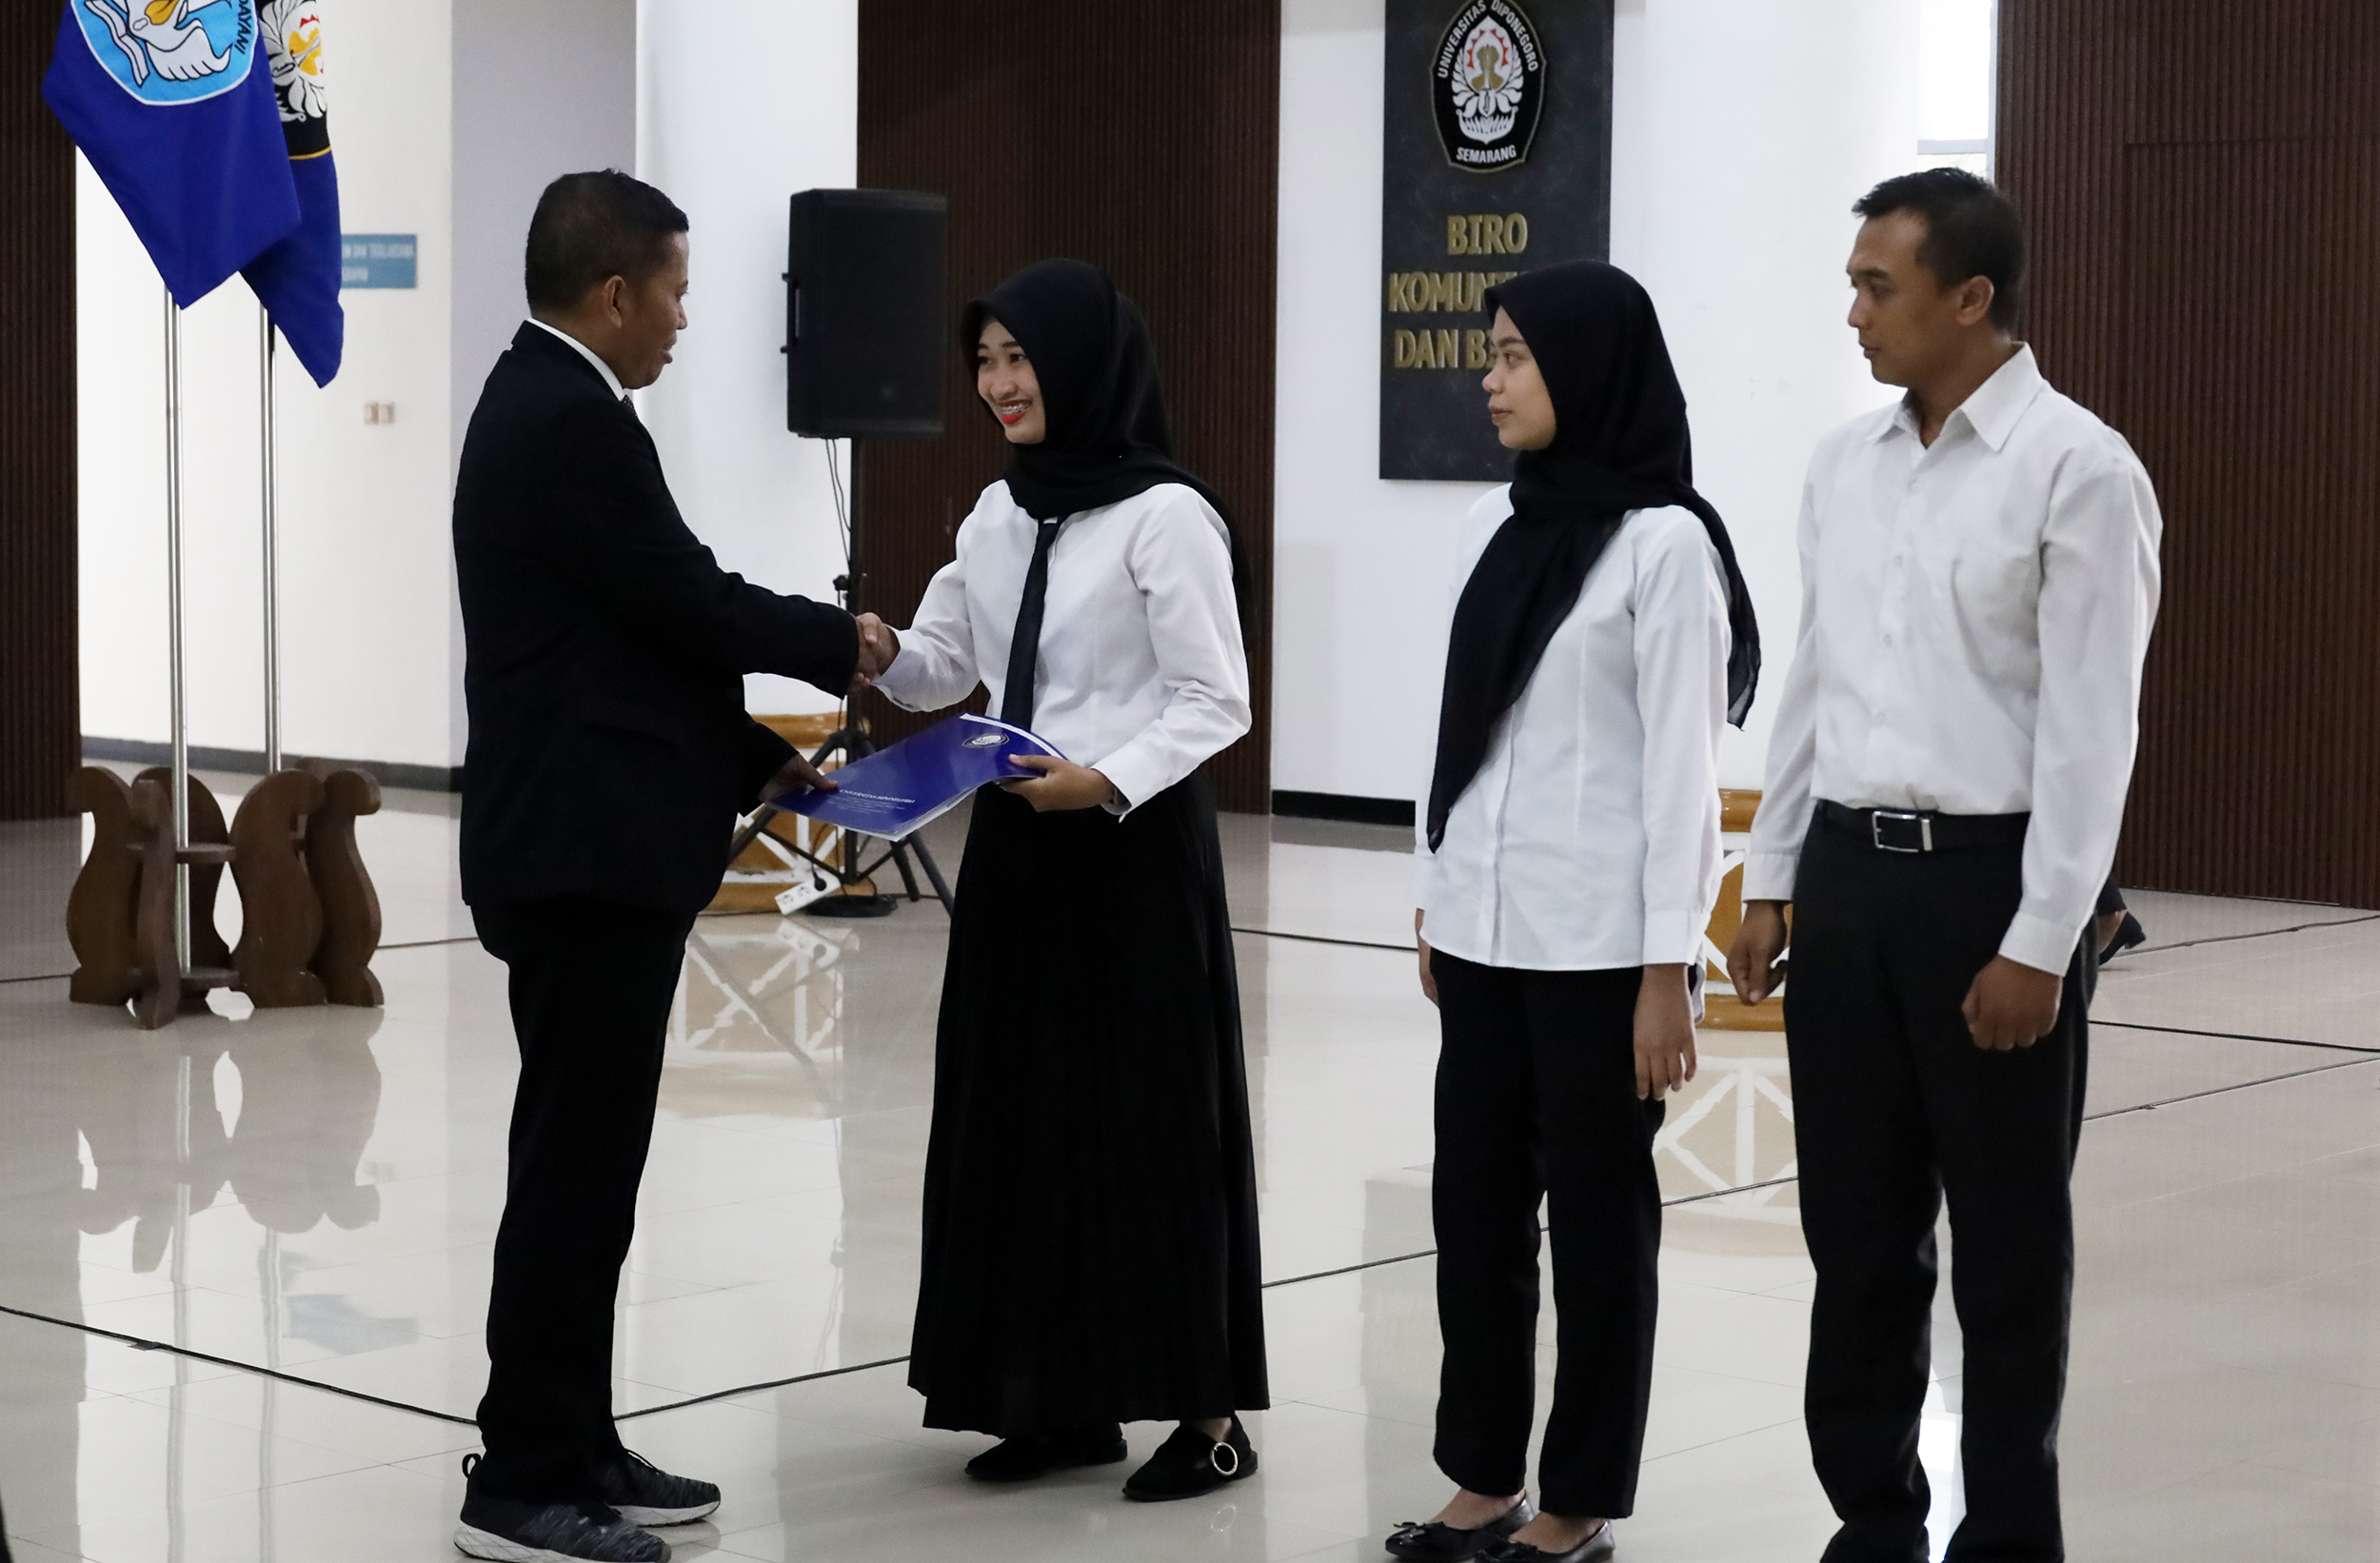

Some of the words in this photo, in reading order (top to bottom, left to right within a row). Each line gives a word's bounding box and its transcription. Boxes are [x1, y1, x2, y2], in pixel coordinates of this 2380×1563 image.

[1437, 0, 1487, 79] UNIVERSITAS
[1490, 0, 1539, 72] DIPONEGORO
[1456, 144, 1517, 164] SEMARANG
[1447, 211, 1529, 255] BIRO
[1388, 270, 1518, 312] KOMUN
[1394, 328, 1458, 369] DAN
